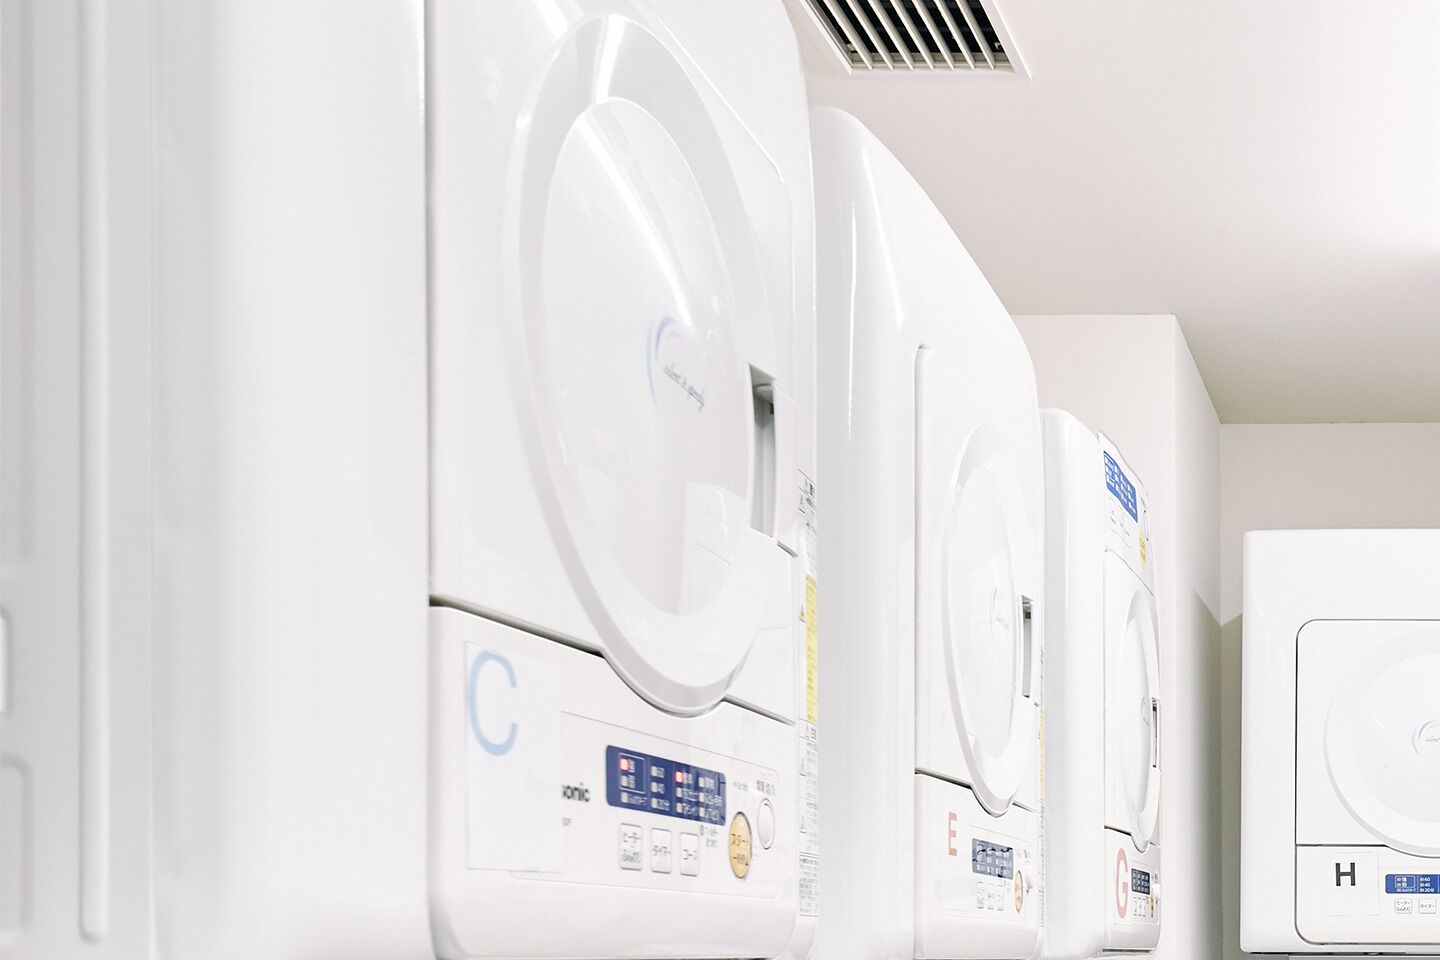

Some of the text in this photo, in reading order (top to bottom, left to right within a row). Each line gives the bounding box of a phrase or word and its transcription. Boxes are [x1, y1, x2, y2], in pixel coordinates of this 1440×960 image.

[468, 648, 518, 757] C
[948, 812, 957, 857] E
[1115, 847, 1129, 919] G
[1335, 862, 1356, 887] H
